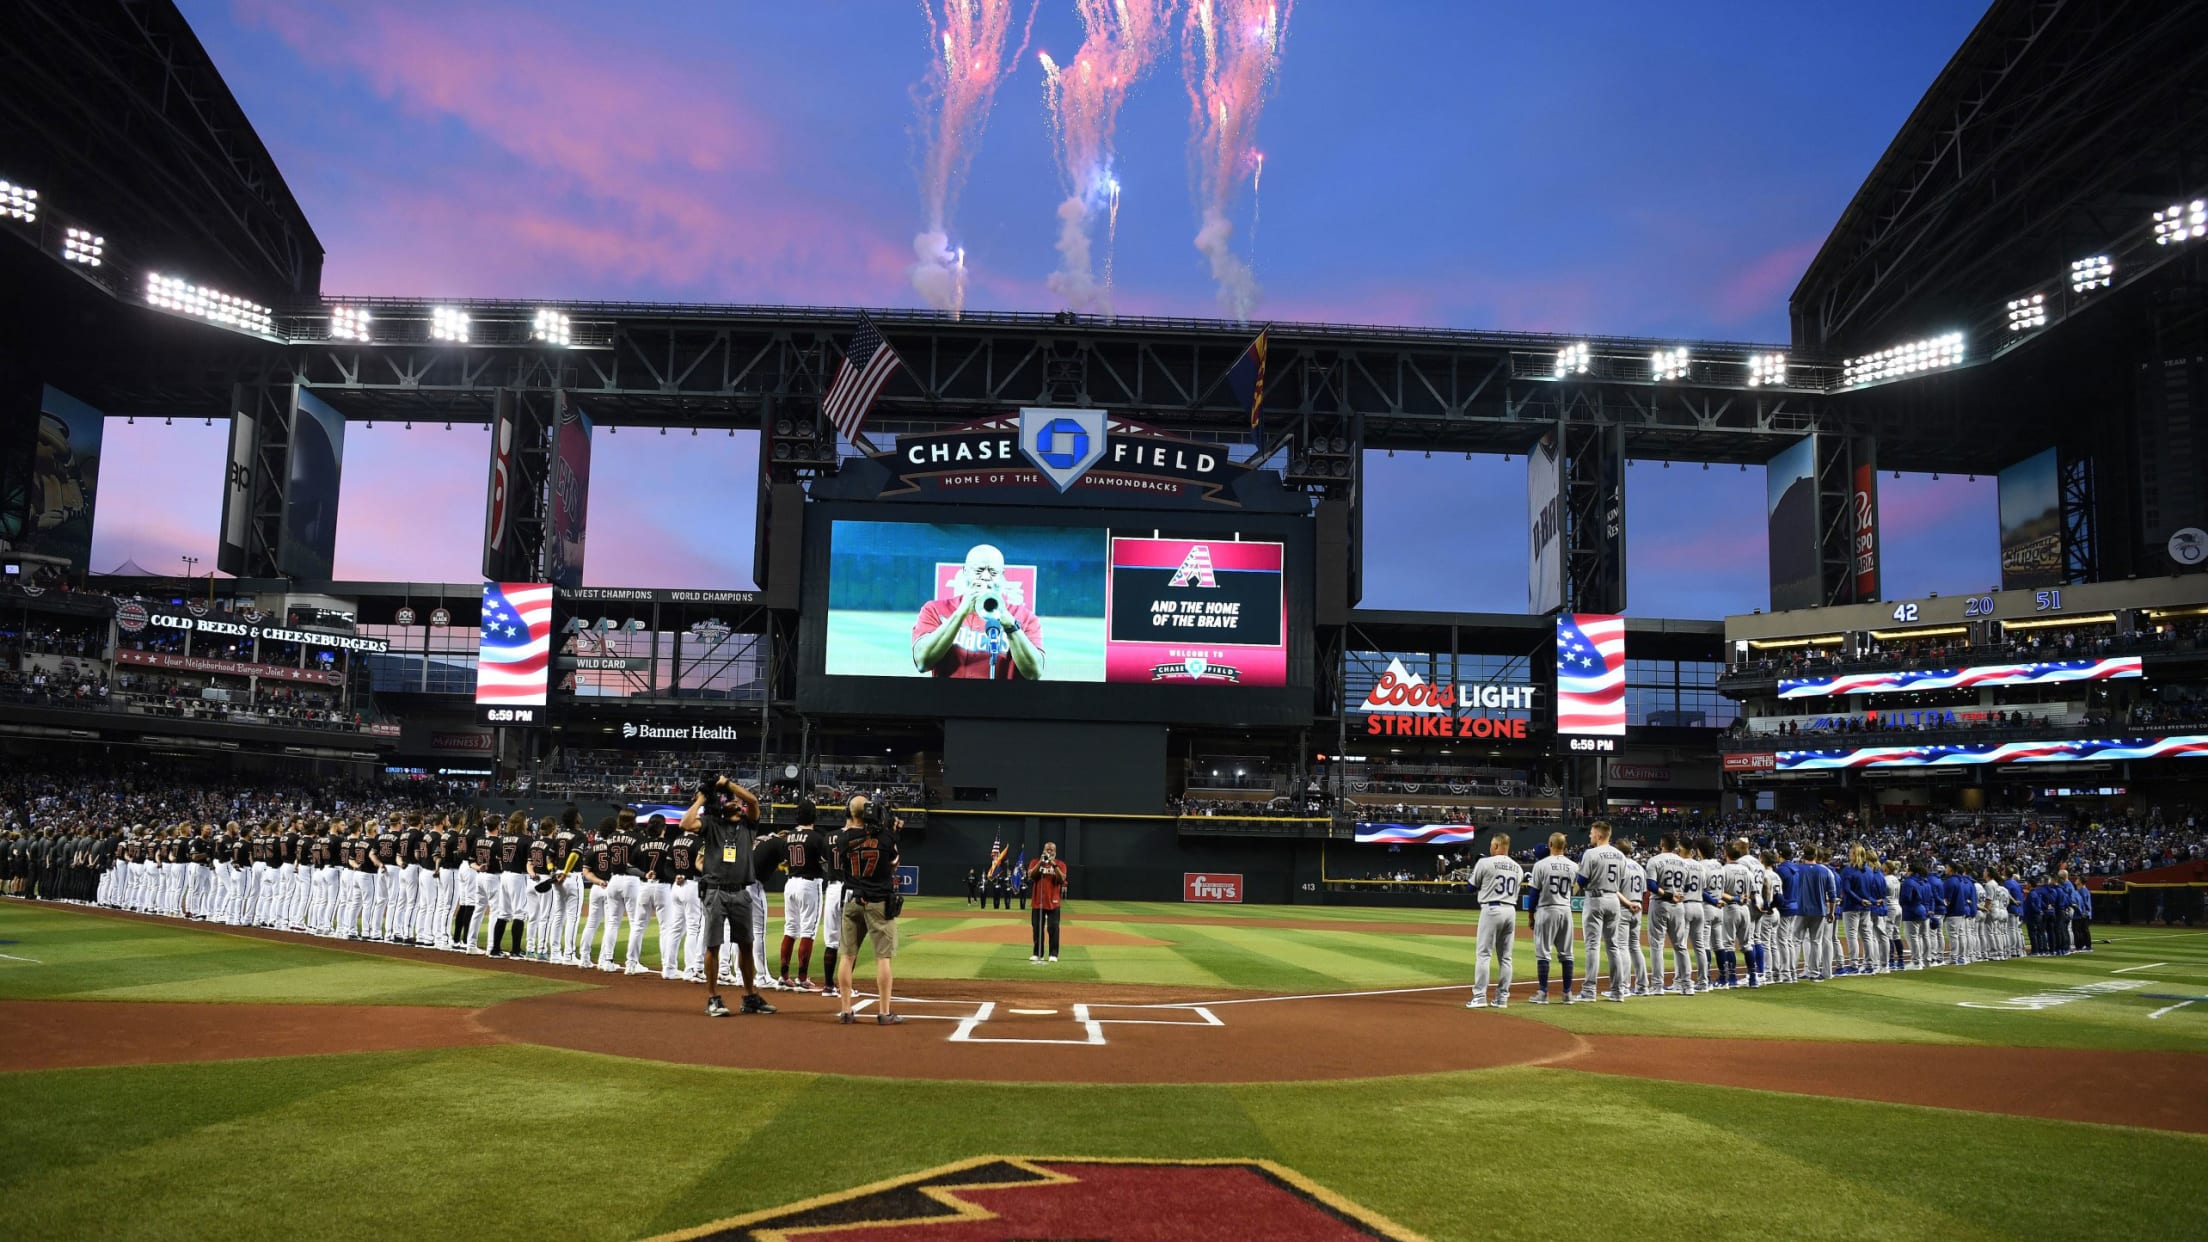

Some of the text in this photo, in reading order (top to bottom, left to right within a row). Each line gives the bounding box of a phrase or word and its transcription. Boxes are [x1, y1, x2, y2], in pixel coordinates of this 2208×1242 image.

[908, 441, 1215, 472] CHASE FIELD
[945, 475, 980, 485] HOME
[1085, 476, 1177, 492] DIAMONDBACKS
[561, 589, 652, 599] NL WEST CHAMPIONS
[671, 592, 753, 602] WORLD CHAMPIONS
[2036, 590, 2061, 611] 51
[1151, 600, 1240, 614] AND THE HOME
[1893, 603, 1918, 622] 42
[1965, 596, 1994, 617] 20
[1152, 614, 1238, 628] OF THE BRAVE
[150, 614, 193, 629] COLD
[197, 619, 247, 636] BEERS
[250, 627, 259, 637] &
[262, 628, 388, 652] CHEESEBURGERS
[1169, 650, 1223, 658] WELCOME TO
[164, 656, 285, 677] Your Neighborhood Burger Joint
[577, 659, 626, 669] WILD CARD
[1158, 665, 1233, 675] CHASE FIELD
[1367, 671, 1536, 708] Coors LIGHT
[488, 709, 533, 721] 6:59 PM
[639, 724, 737, 740] Banner Health
[1367, 714, 1527, 738] STRIKE ZONE
[1570, 739, 1614, 751] 6:59 PM
[611, 845, 628, 865] 31
[640, 841, 670, 852] CARROLL
[789, 844, 805, 867] 10
[598, 852, 608, 871] 5
[648, 851, 660, 871] 7
[673, 849, 689, 869] 53
[847, 850, 879, 878] 17
[1551, 863, 1570, 872] BETTS
[1608, 864, 1616, 883] 5
[1664, 870, 1683, 888] 28
[1709, 875, 1723, 890] 33
[1190, 876, 1236, 899] fry's
[1302, 883, 1315, 891] 413
[1494, 875, 1516, 896] 30
[1550, 875, 1571, 897] 50
[1631, 875, 1642, 893] 13
[1689, 875, 1698, 892] 6
[1736, 880, 1744, 894] 3
